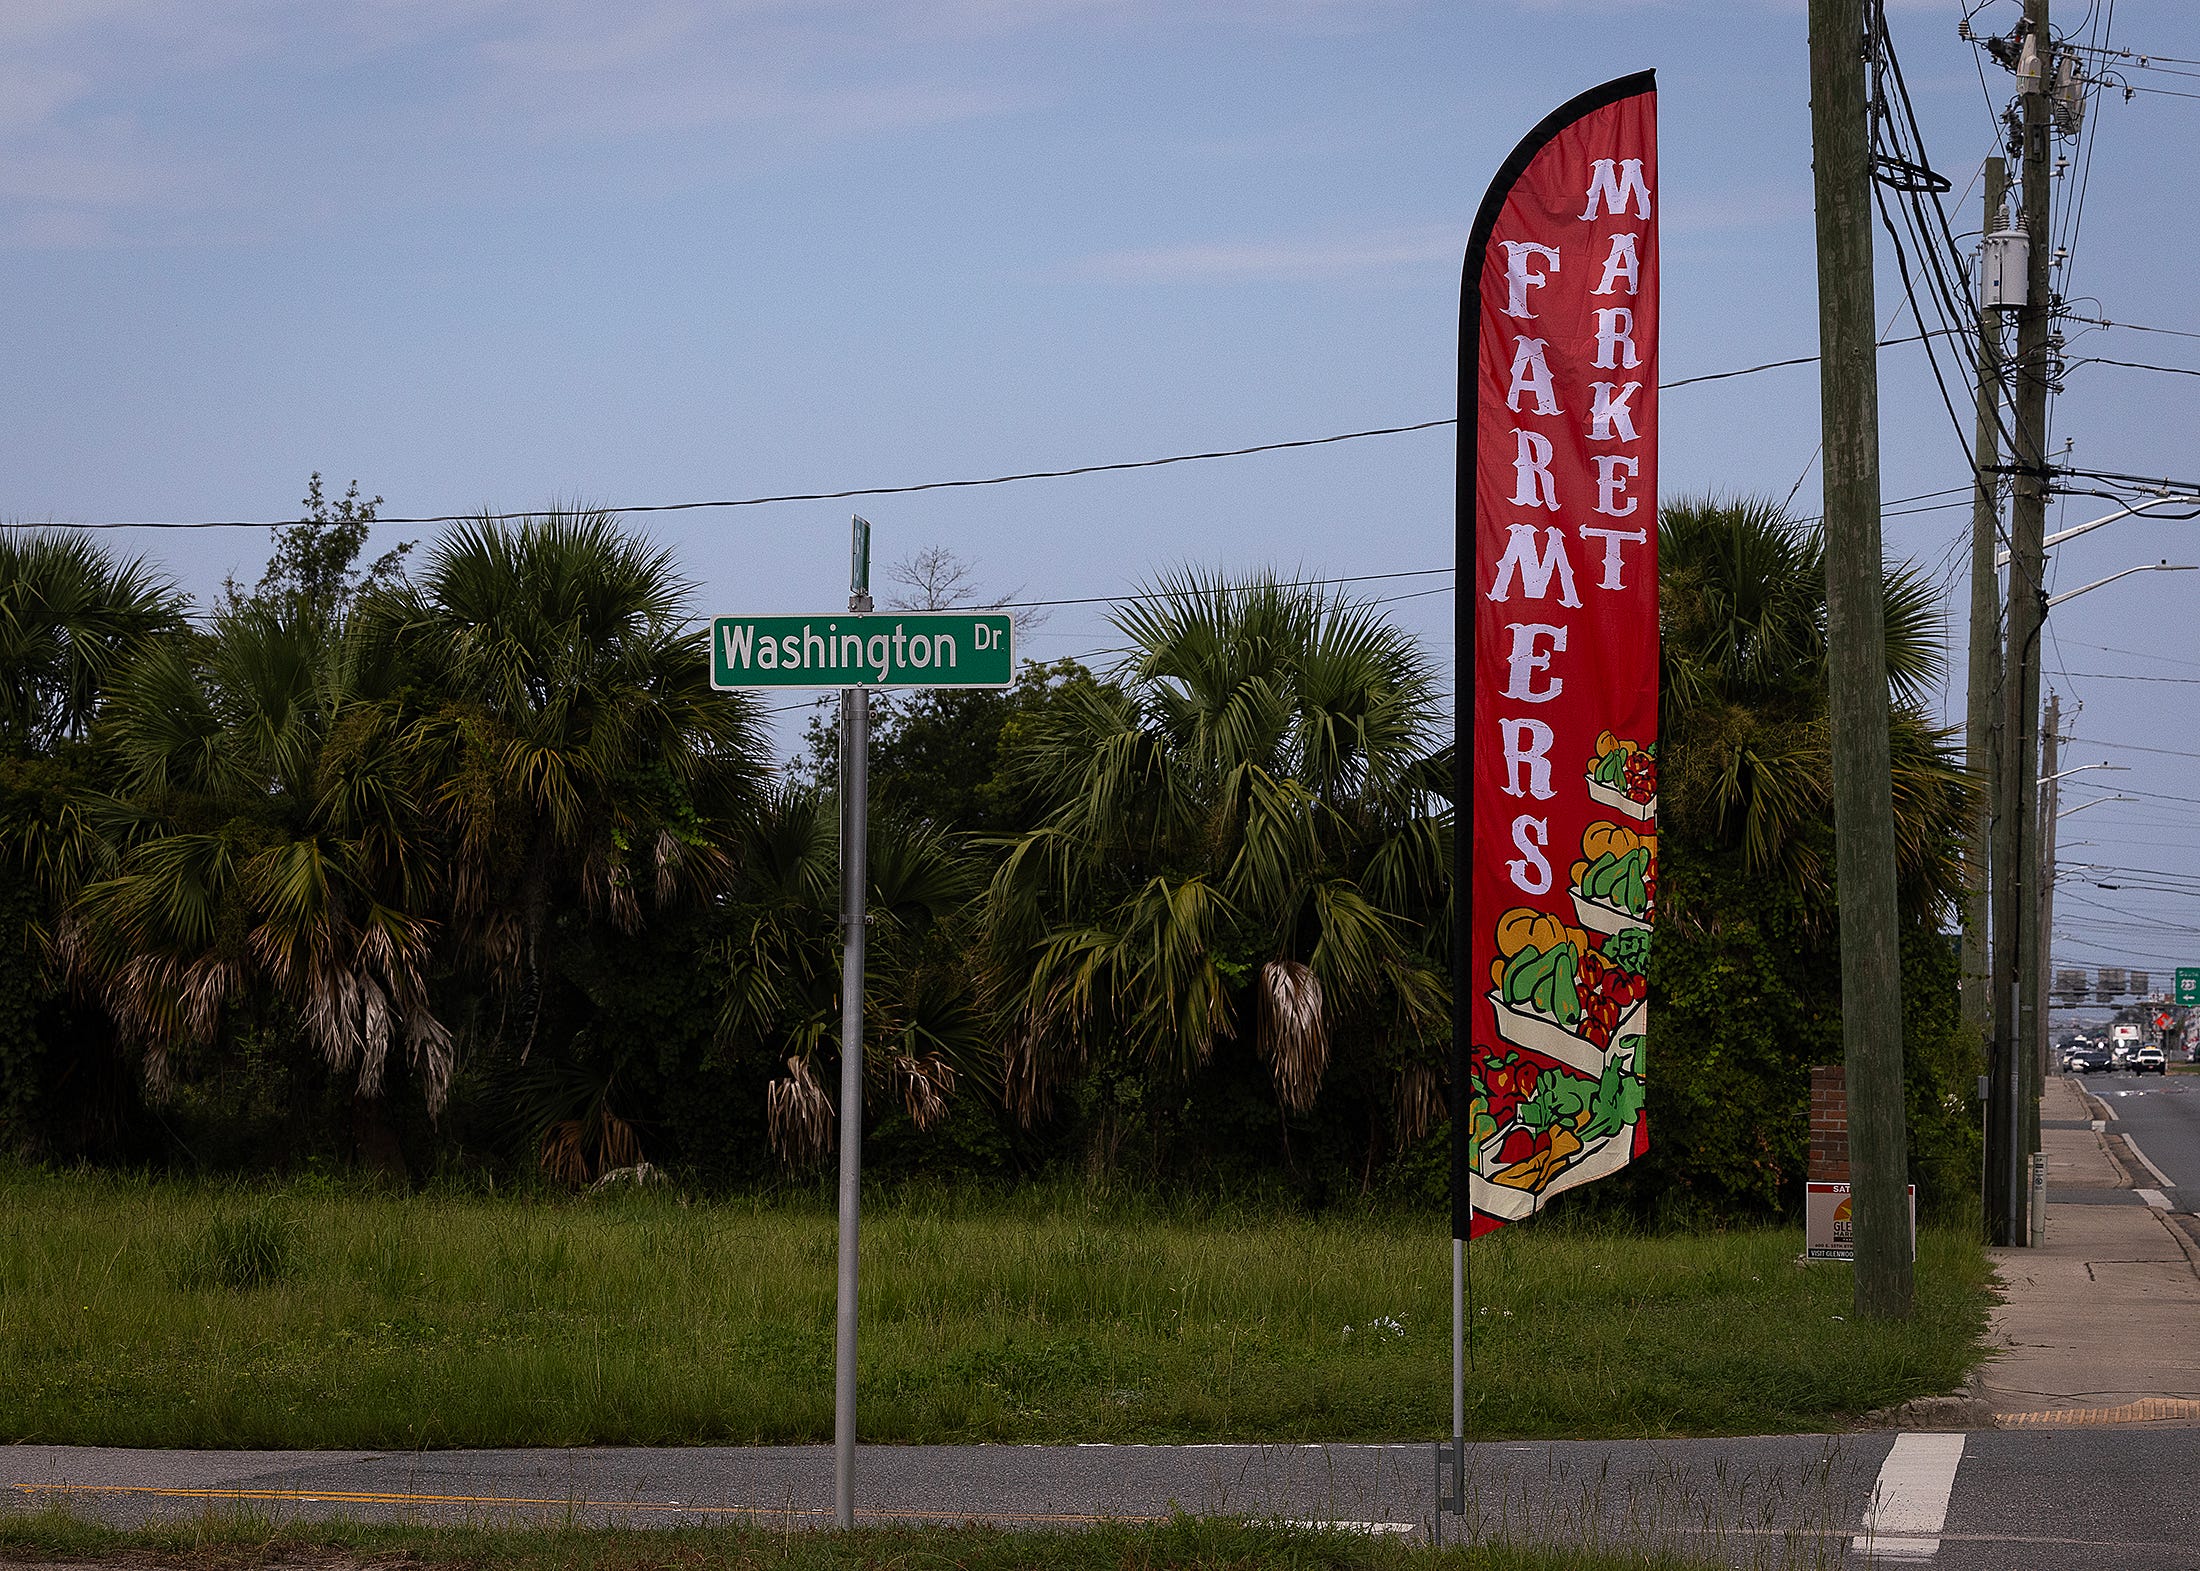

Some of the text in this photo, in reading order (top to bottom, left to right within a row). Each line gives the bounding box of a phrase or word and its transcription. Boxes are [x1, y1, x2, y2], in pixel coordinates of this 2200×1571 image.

[1577, 158, 1651, 590] MARKET
[722, 623, 1002, 683] Washington Dr
[1485, 240, 1583, 895] FARMERS
[1833, 1221, 1852, 1231] GLE
